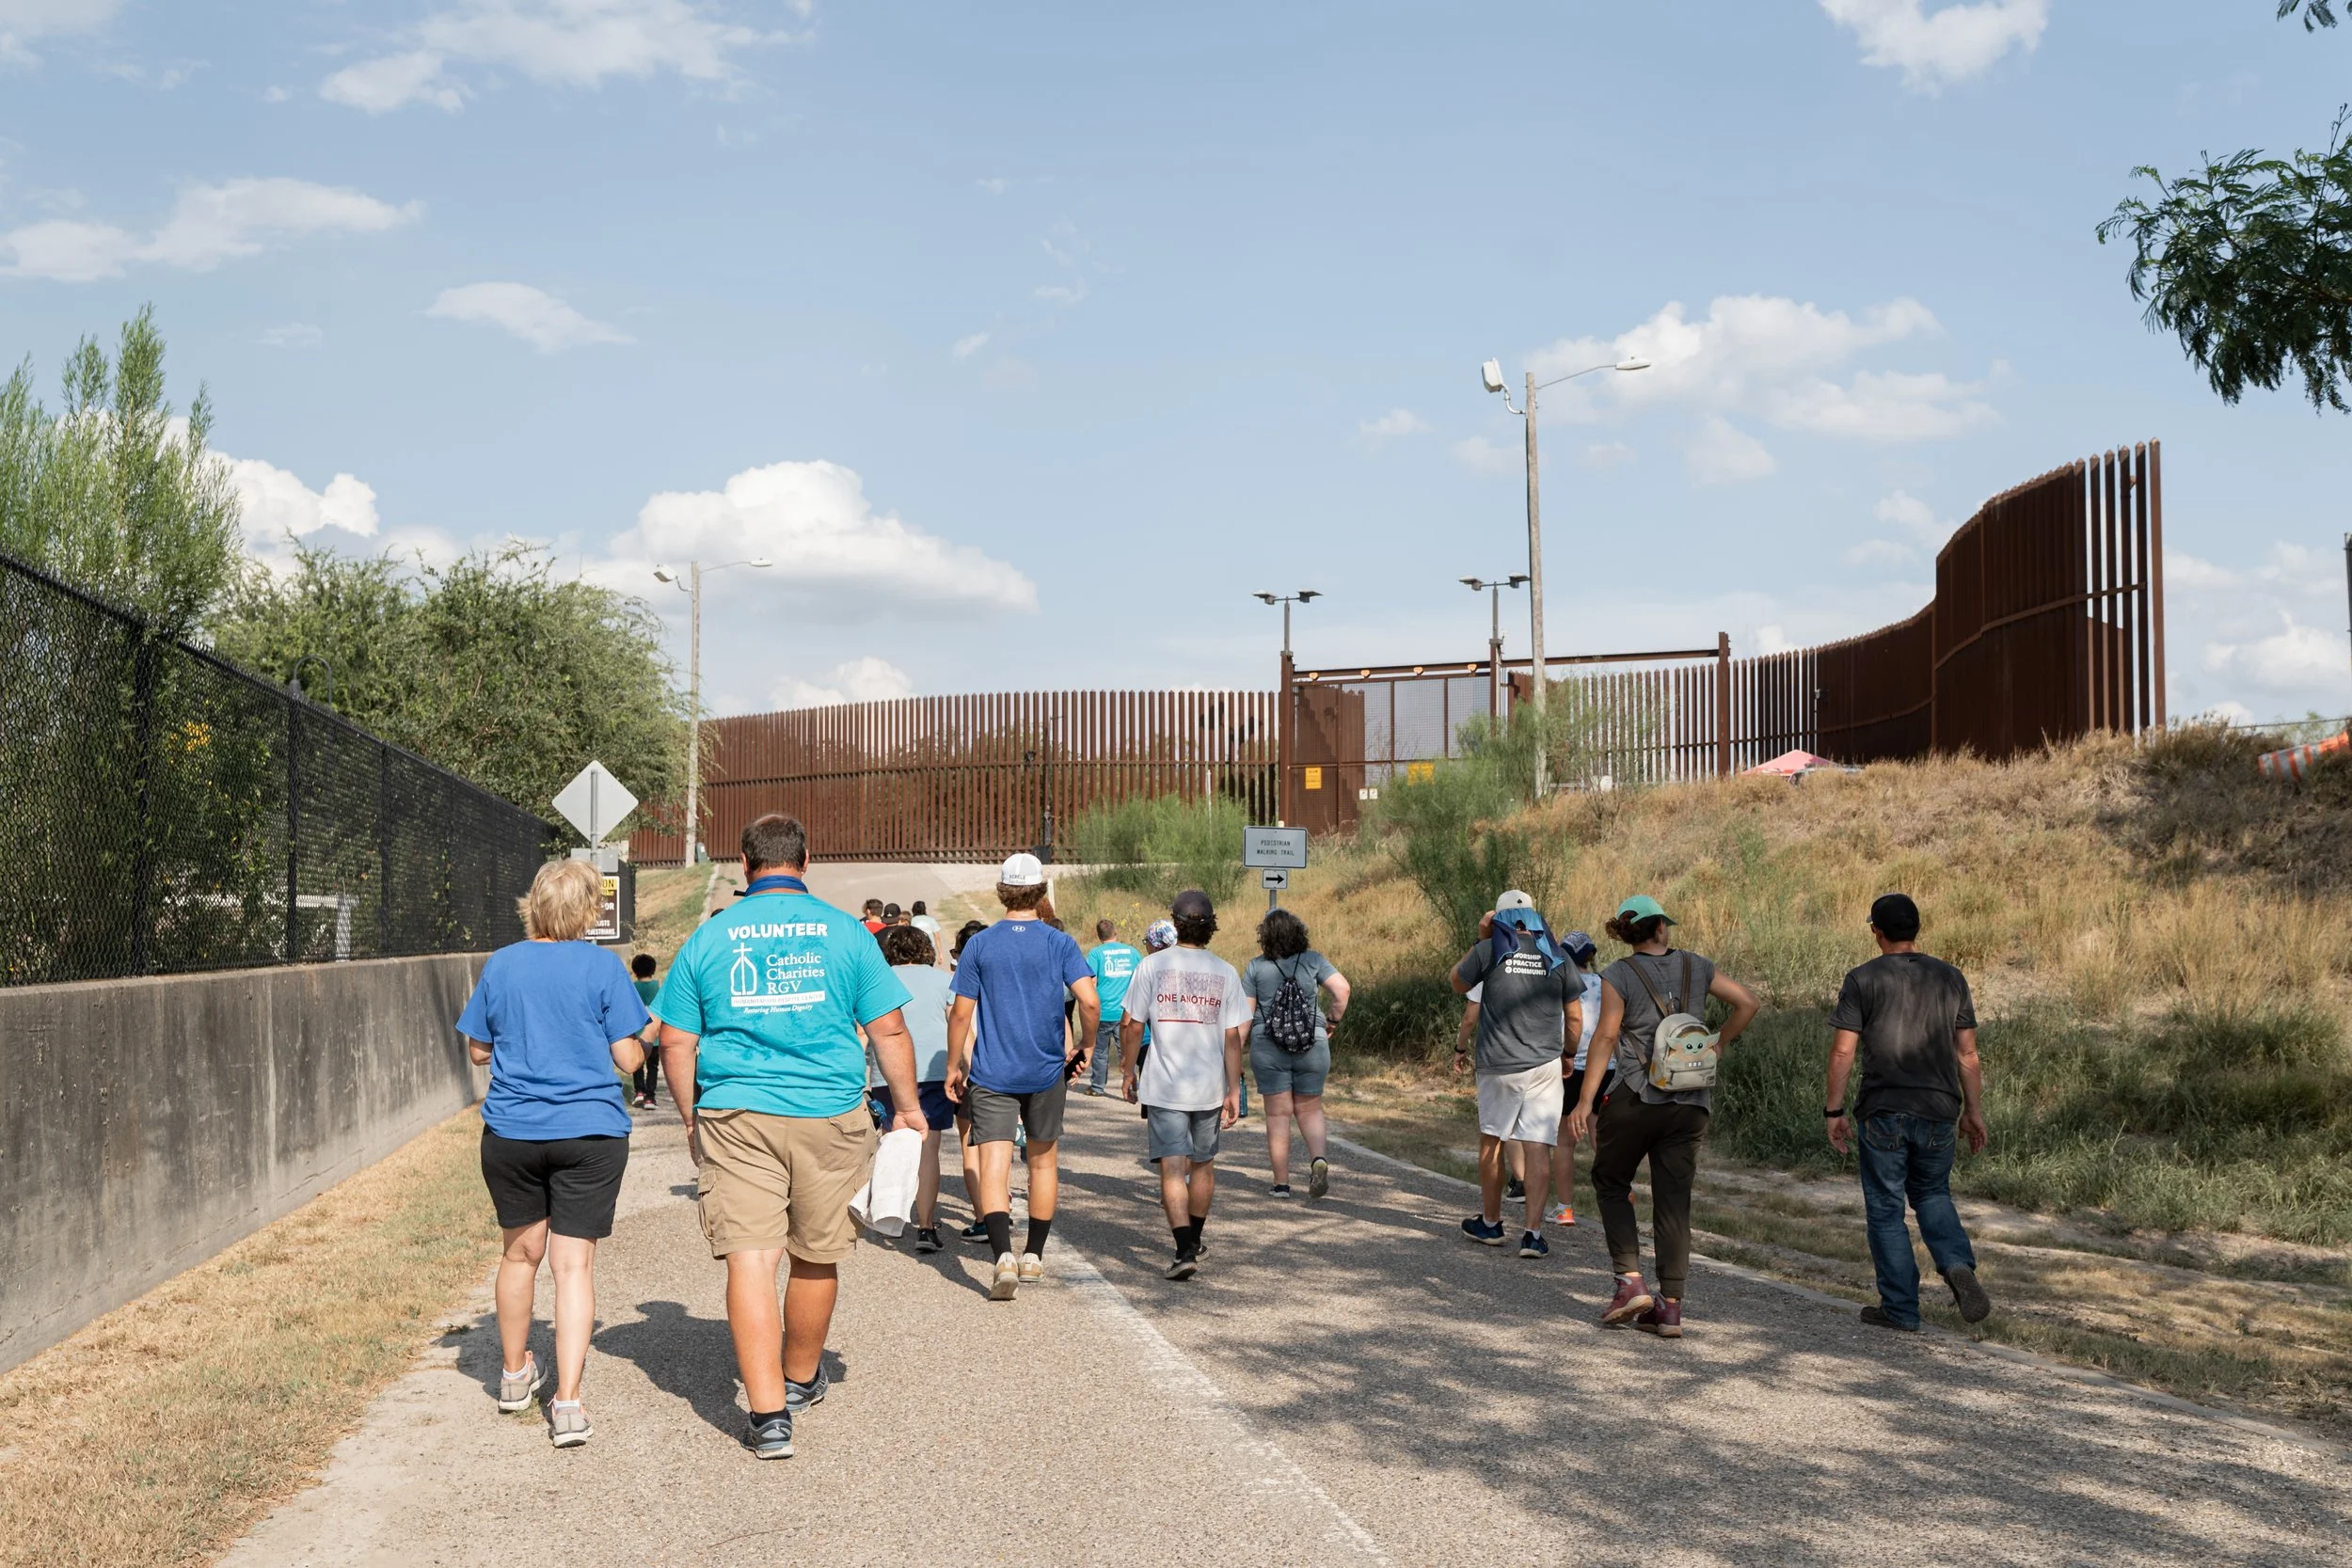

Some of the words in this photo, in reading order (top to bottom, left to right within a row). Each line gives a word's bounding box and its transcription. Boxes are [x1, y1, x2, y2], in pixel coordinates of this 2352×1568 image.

[727, 923, 828, 941] VOLUNTEER
[766, 952, 821, 966] Catholic
[766, 966, 825, 980] Charities
[767, 980, 802, 994] RGV
[1156, 993, 1177, 1003] ONE
[1180, 994, 1221, 1008] ANOTHER
[791, 1004, 813, 1012] Dignity
